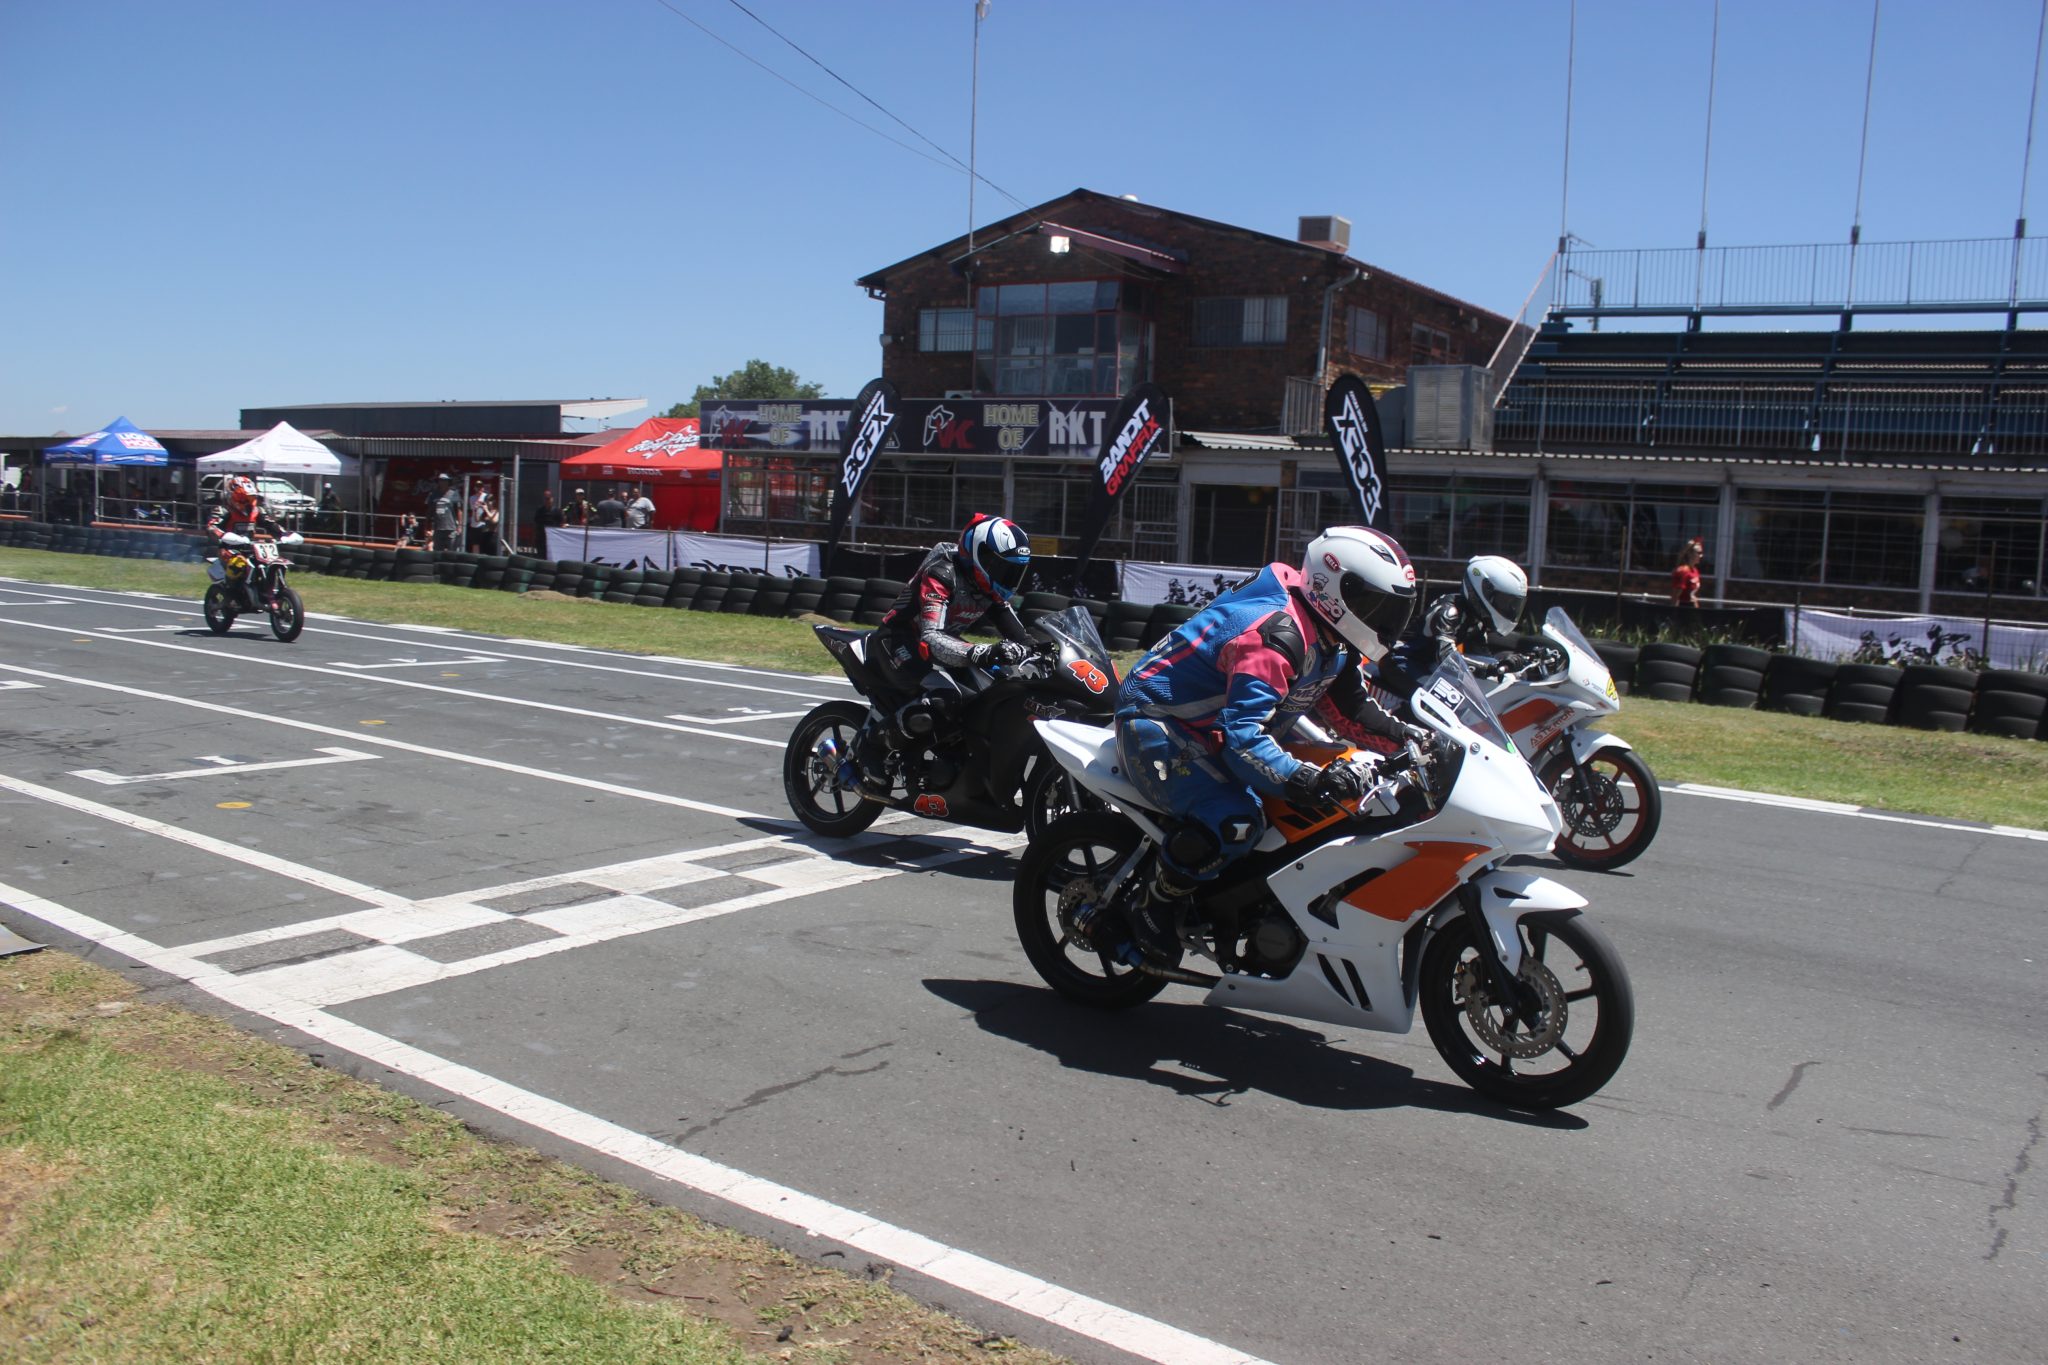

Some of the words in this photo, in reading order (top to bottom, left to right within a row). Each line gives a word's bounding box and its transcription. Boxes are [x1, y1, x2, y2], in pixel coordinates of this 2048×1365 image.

[757, 404, 803, 424] HOME
[983, 404, 1040, 427] HOME
[769, 426, 792, 446] OF
[997, 427, 1025, 450] OF
[1048, 410, 1107, 445] RKT
[1100, 398, 1151, 484] BANDIT
[1106, 415, 1161, 496] GRAFFIX
[1066, 659, 1109, 694] 43
[914, 794, 950, 817] 43
